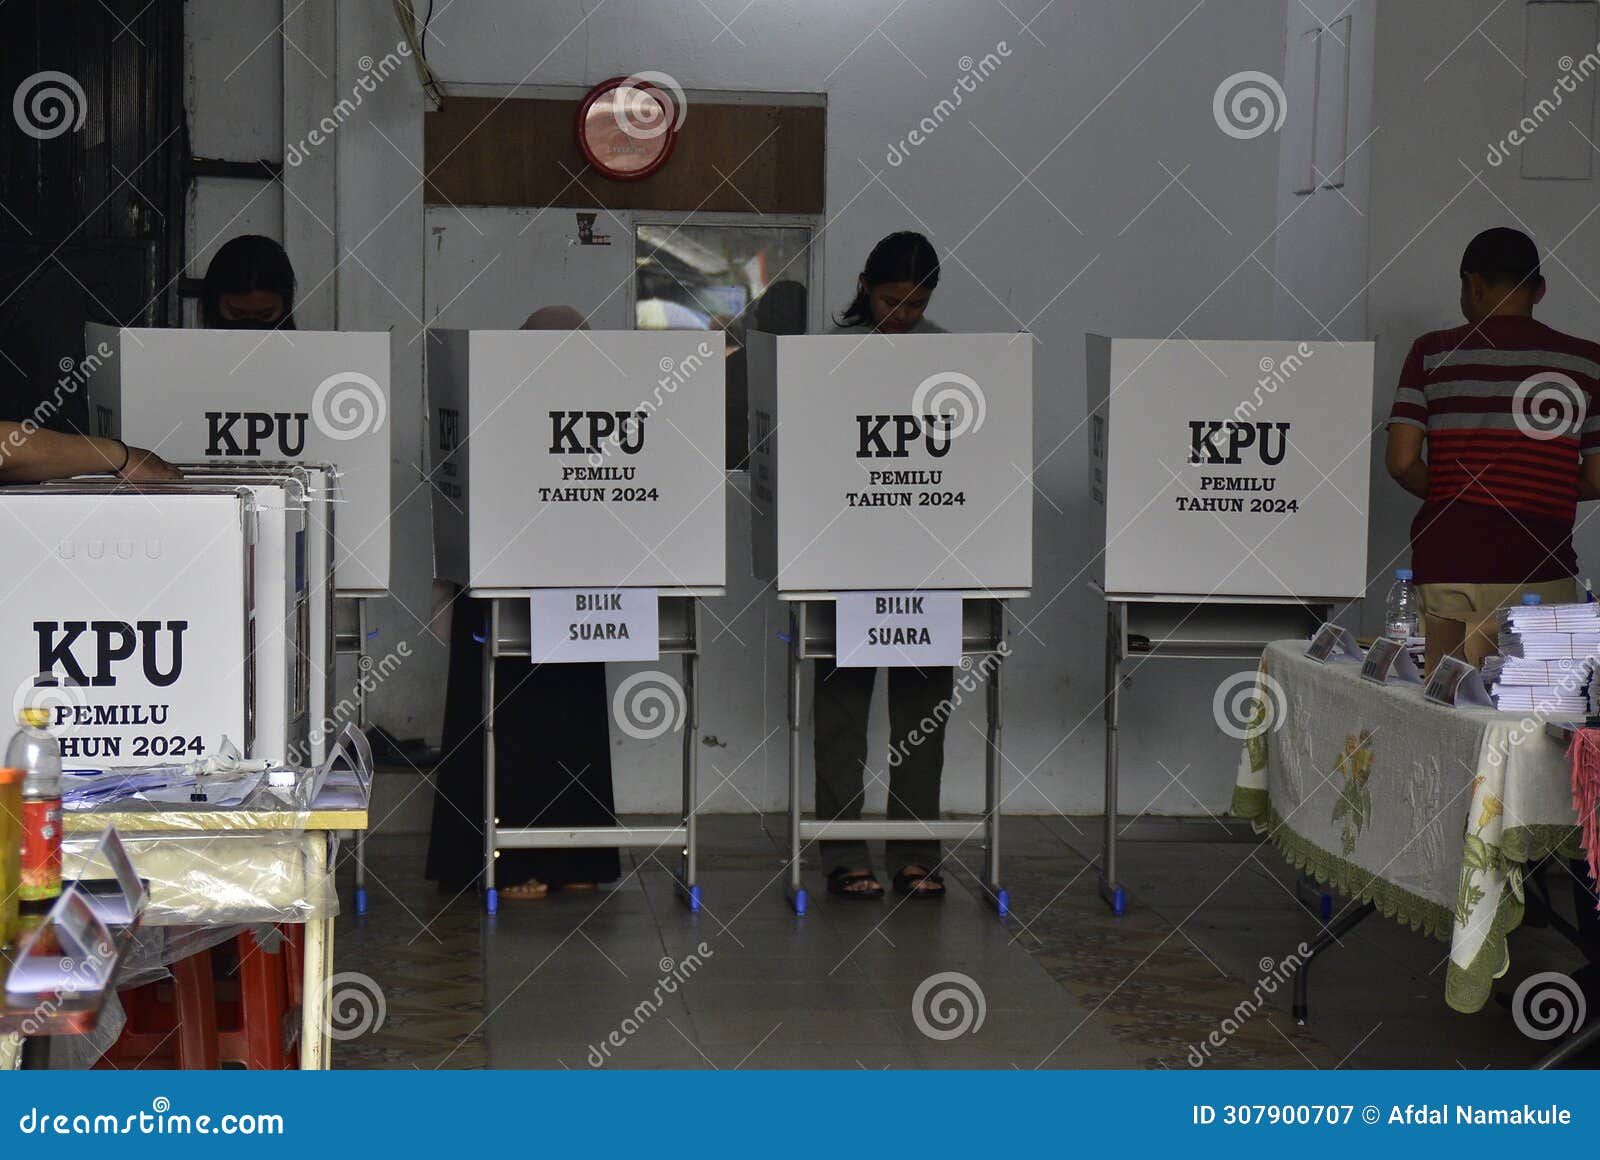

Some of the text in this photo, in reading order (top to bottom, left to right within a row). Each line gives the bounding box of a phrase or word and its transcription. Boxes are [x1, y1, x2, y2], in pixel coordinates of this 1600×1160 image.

[204, 412, 309, 457] KPU
[549, 411, 648, 455] KPU
[856, 415, 952, 459] KPU
[1188, 421, 1290, 465] KPU
[562, 467, 635, 481] PEMILU
[870, 471, 942, 486] PEMILU
[1200, 477, 1276, 492] PEMILU
[539, 488, 659, 502] TAHUN 2024
[846, 492, 966, 507] TAHUN 2024
[1176, 497, 1299, 513] TAHUN 2024
[576, 593, 622, 611] BILIK
[875, 596, 924, 615] BILIK
[569, 622, 629, 641] SUARA
[868, 627, 931, 646] SUARA
[33, 621, 188, 687] KPU
[54, 705, 169, 725] PEMILU
[58, 736, 206, 758] HUN 2024
